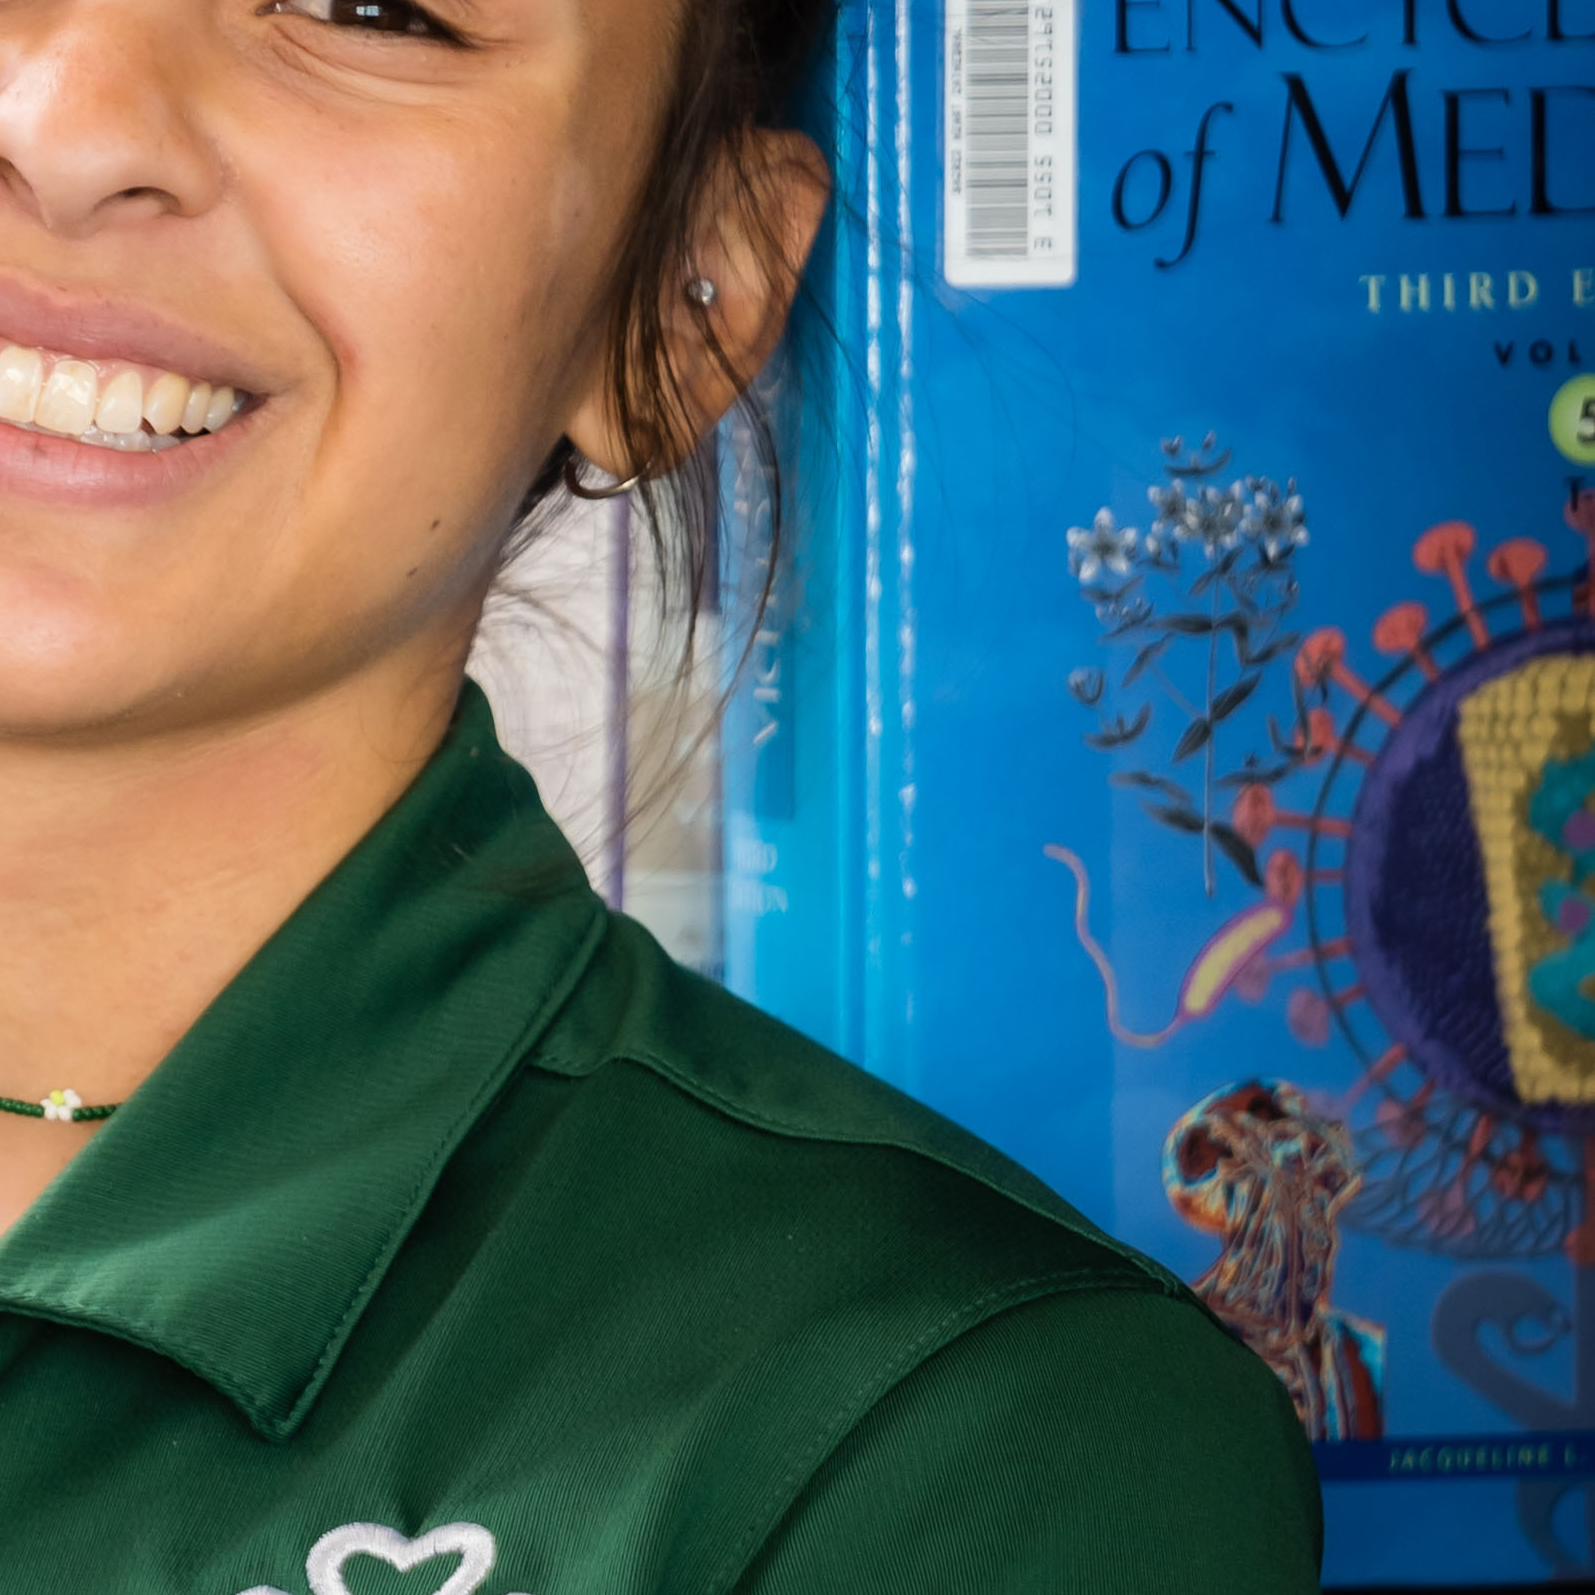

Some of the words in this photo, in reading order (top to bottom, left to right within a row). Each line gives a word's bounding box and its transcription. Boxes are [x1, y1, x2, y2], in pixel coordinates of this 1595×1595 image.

[1111, 101, 1235, 269] of
[1358, 270, 1539, 314] THIRD
[1493, 337, 1583, 369] VOL
[1389, 1441, 1550, 1474] JACQUELINE
